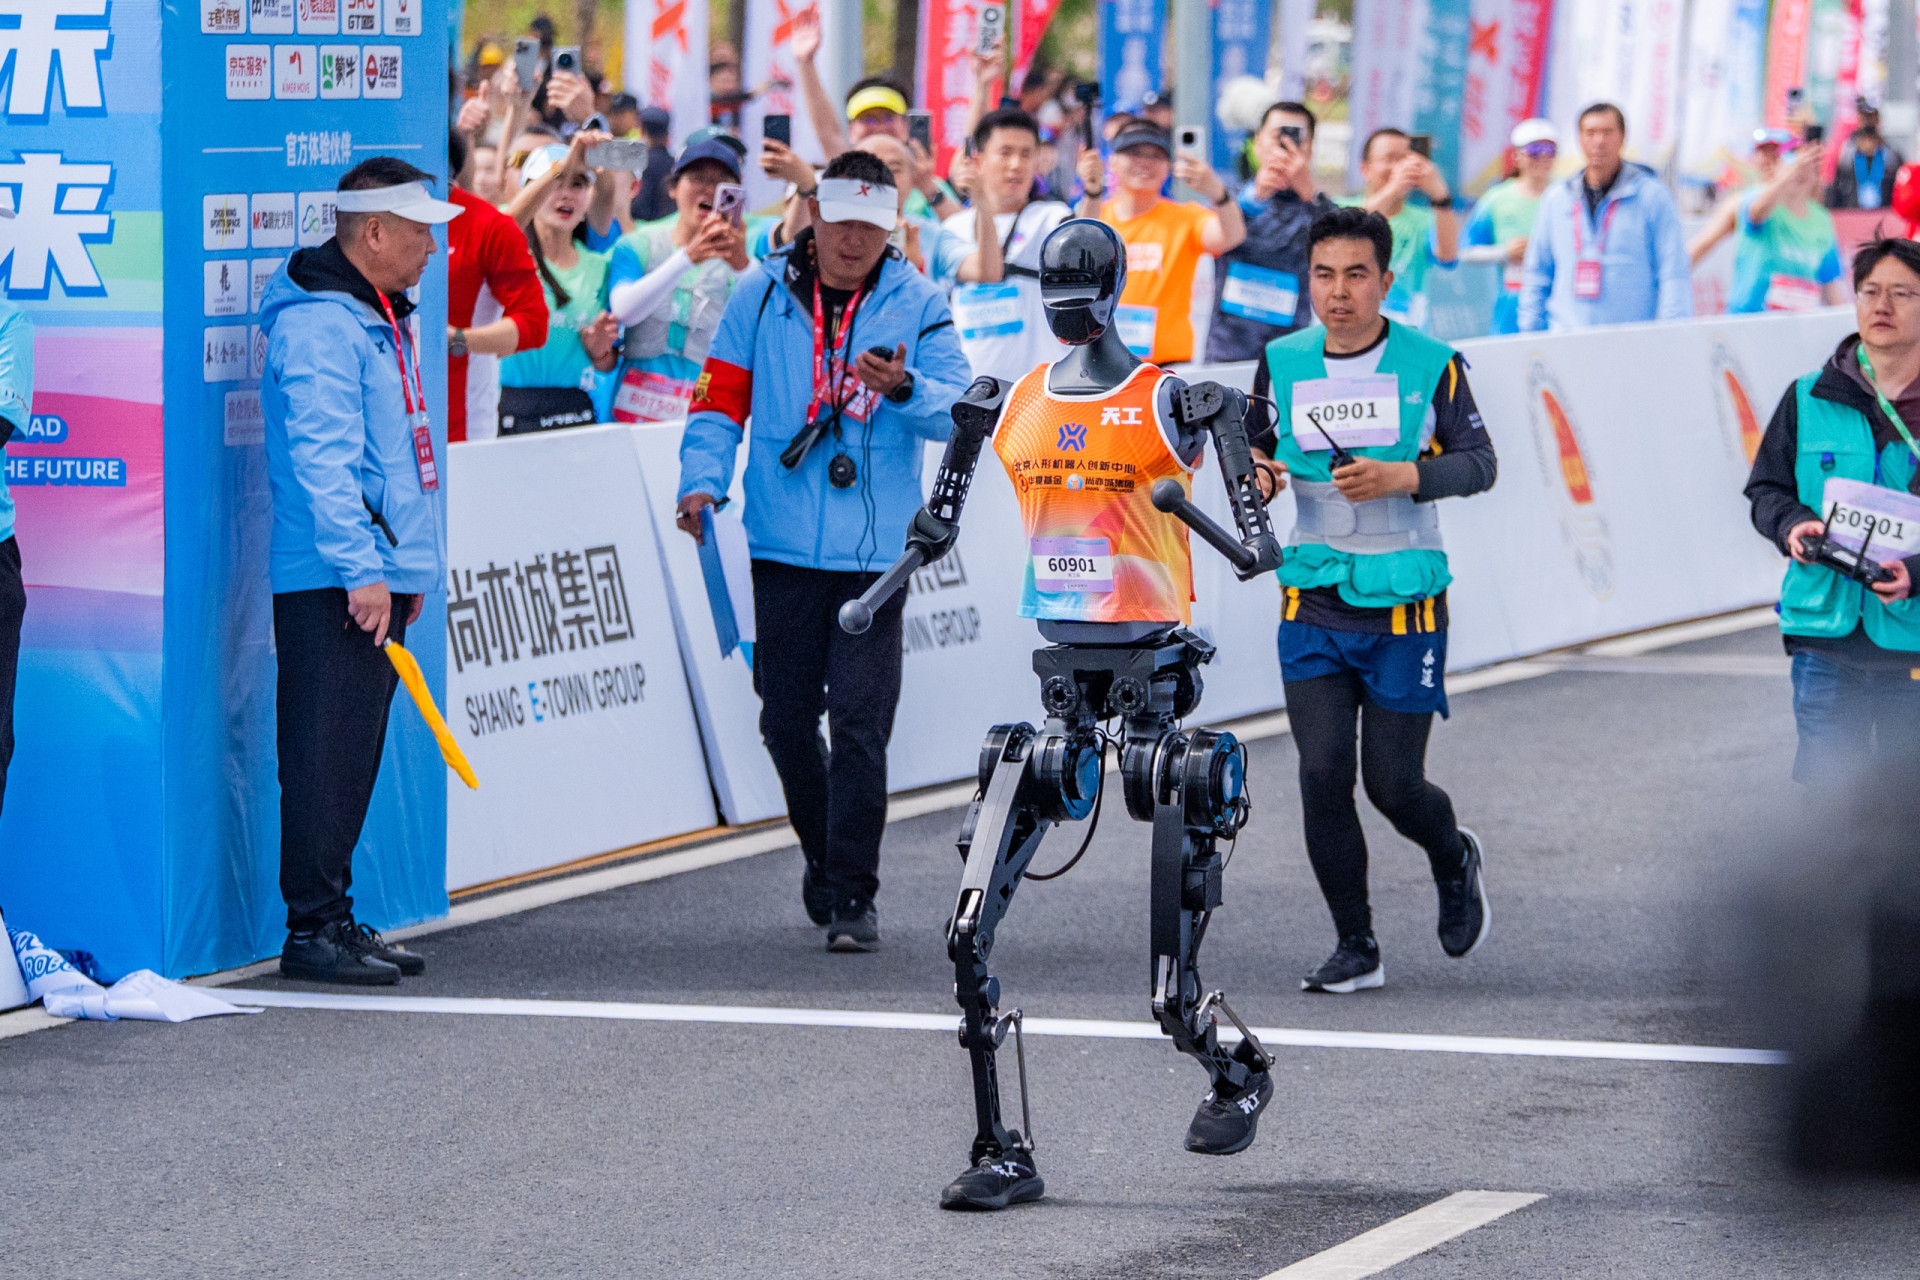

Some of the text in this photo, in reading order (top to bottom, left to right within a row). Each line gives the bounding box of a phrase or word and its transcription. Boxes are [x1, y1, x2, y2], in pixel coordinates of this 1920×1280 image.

[285, 130, 352, 166] 官方体验伙伴
[1100, 407, 1143, 426] 天工
[1310, 402, 1378, 422] 60901
[34, 460, 120, 480] FUTURE
[1014, 458, 1136, 475] 北京人形机器人创新中心
[1028, 475, 1063, 485] 华夏基金
[1085, 477, 1135, 489] 尚亦城集团
[1834, 507, 1904, 540] 60901
[1048, 557, 1097, 573] 60901
[447, 544, 636, 673] 尚亦城集团
[465, 684, 525, 737] SHANG
[592, 662, 646, 709] GROUP
